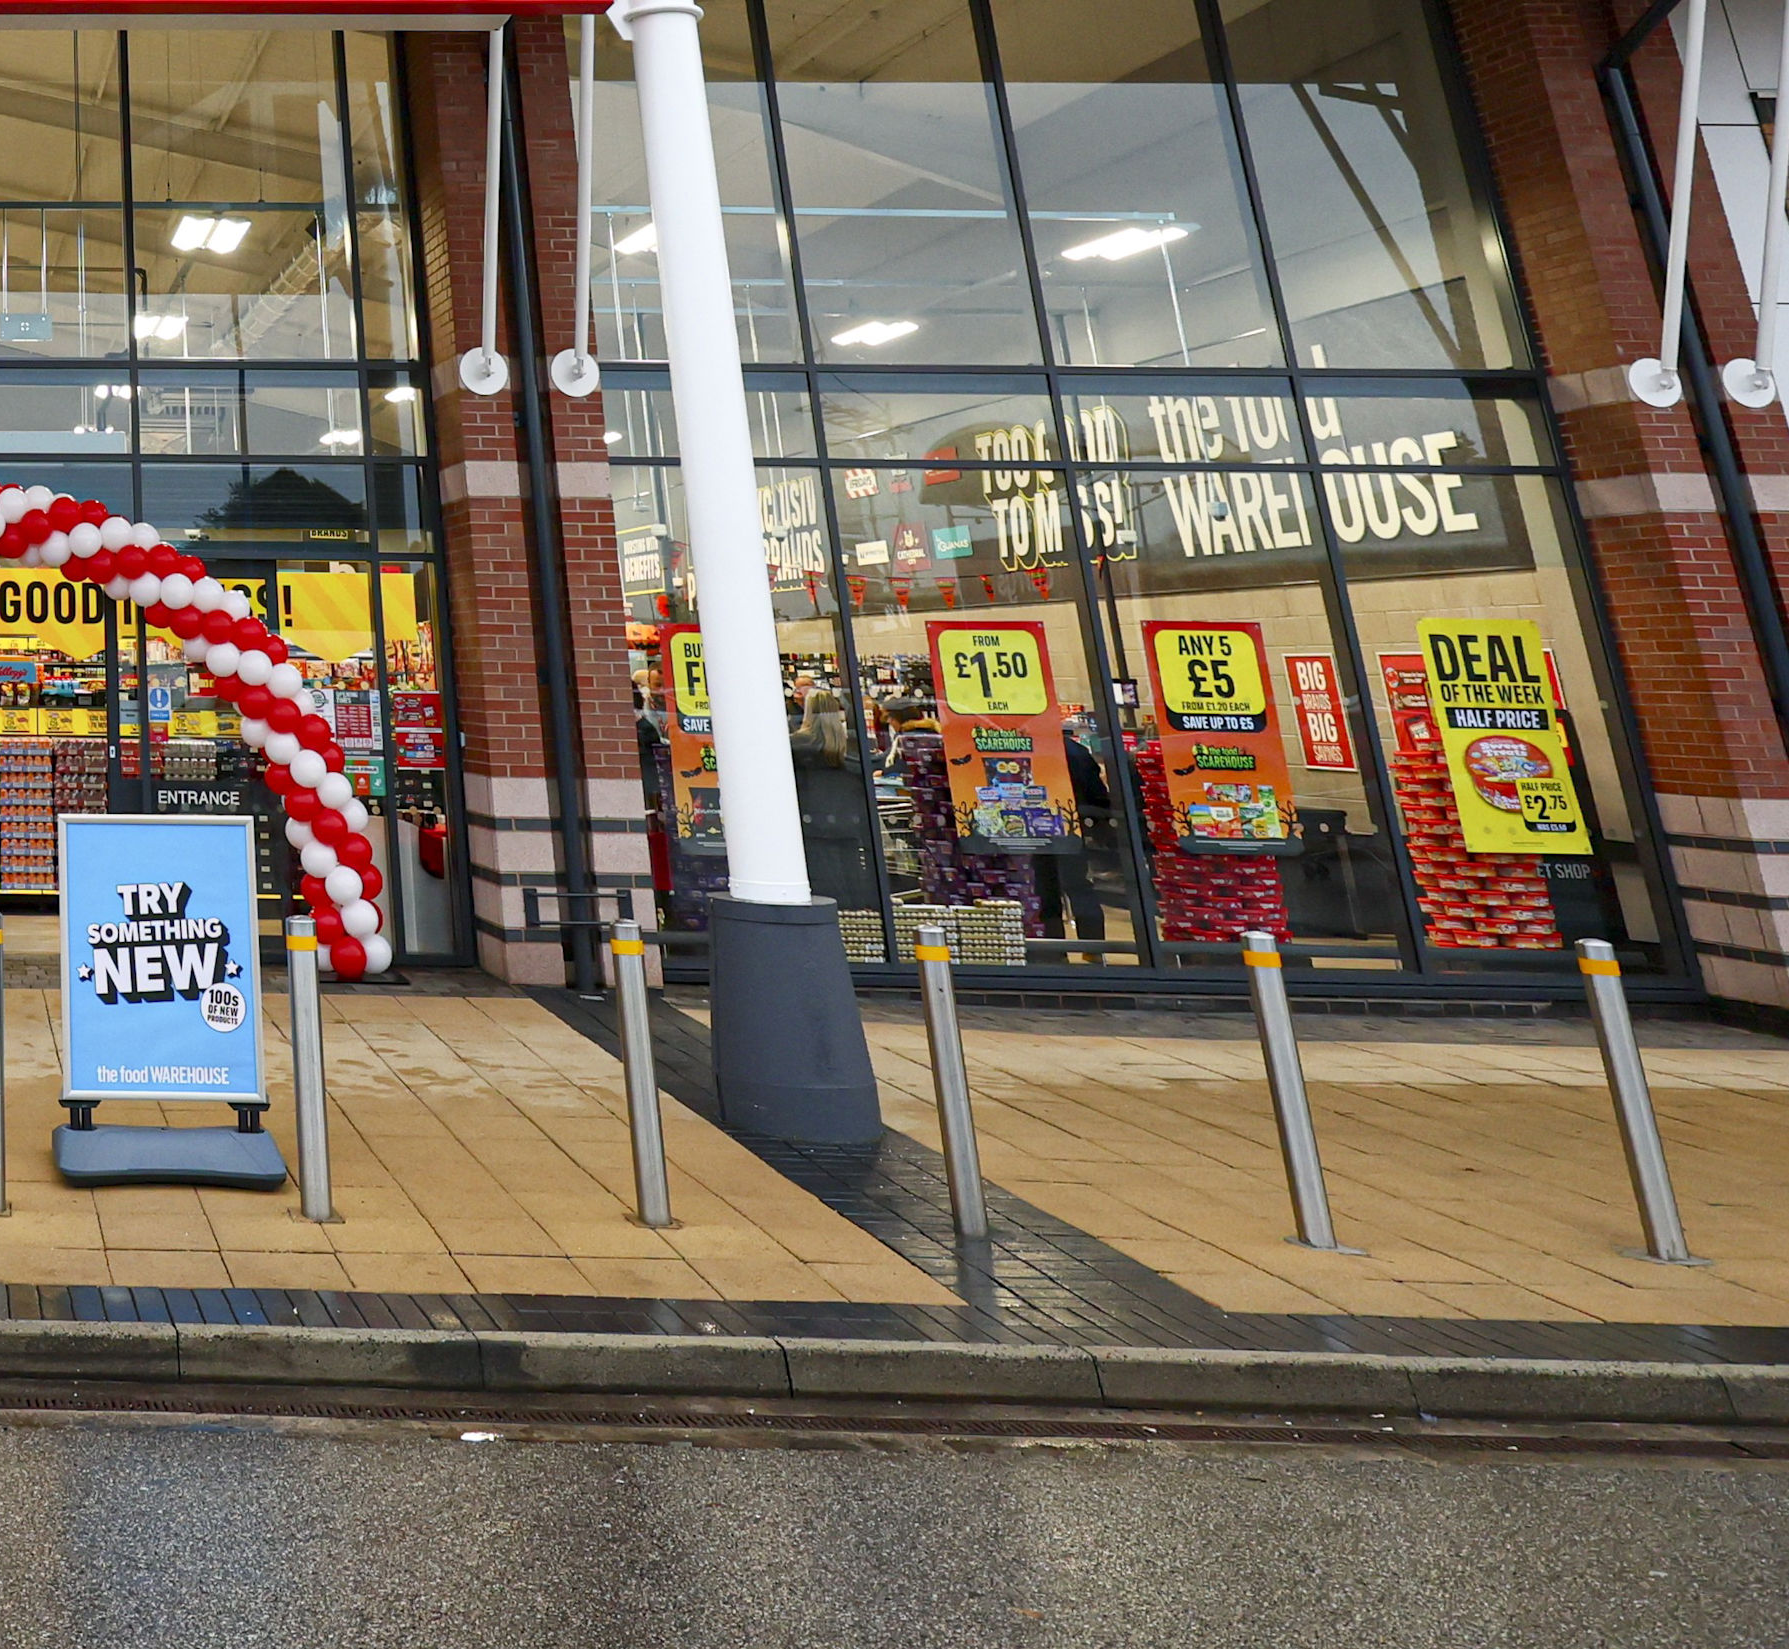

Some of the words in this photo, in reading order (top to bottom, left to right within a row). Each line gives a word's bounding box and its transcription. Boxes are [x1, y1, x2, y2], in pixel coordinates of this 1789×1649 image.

[0, 581, 105, 624] GOOD
[972, 635, 1000, 647] FROM
[1178, 635, 1214, 656] ANY
[1220, 636, 1232, 656] 5
[684, 643, 704, 658] BU
[1428, 634, 1542, 683] DEAL
[954, 651, 1028, 698] £1.50
[1188, 659, 1236, 699] £5
[1295, 661, 1327, 691] BIG
[1301, 693, 1332, 711] BRANDS
[1441, 683, 1460, 703] OF
[1462, 684, 1495, 704] THE
[1496, 684, 1545, 704] WEEK
[695, 701, 709, 710] FRO
[988, 701, 1009, 711] EACH
[1182, 701, 1204, 712] FROM
[1229, 701, 1251, 712] EACH
[683, 718, 711, 732] SAVE
[1182, 716, 1209, 730] SAVE
[1209, 716, 1225, 729] UP
[1225, 716, 1238, 730] TO
[1239, 716, 1255, 731] £5
[1306, 712, 1339, 743] BIG
[1455, 708, 1495, 728] HALF
[1496, 710, 1541, 729] PRICE
[975, 737, 1033, 752] SCAREHOUSE
[1196, 754, 1255, 769] SCAREHOUSE
[1521, 782, 1539, 792] HALF
[1541, 782, 1563, 792] PRICE
[158, 790, 241, 807] ENTRANCE
[1524, 795, 1568, 820] £2.75
[1536, 863, 1552, 879] ET
[1554, 863, 1591, 879] SHOP
[117, 882, 183, 916] TRY
[87, 918, 222, 944] SOMETHING
[93, 943, 219, 995] NEW
[208, 989, 239, 1007] 100s
[207, 1015, 238, 1026] PRODUCTS
[208, 1005, 218, 1017] OF
[220, 1006, 239, 1018] NEW
[97, 1066, 117, 1084] the
[120, 1066, 148, 1084] food
[150, 1066, 230, 1085] WAREHOUSE
